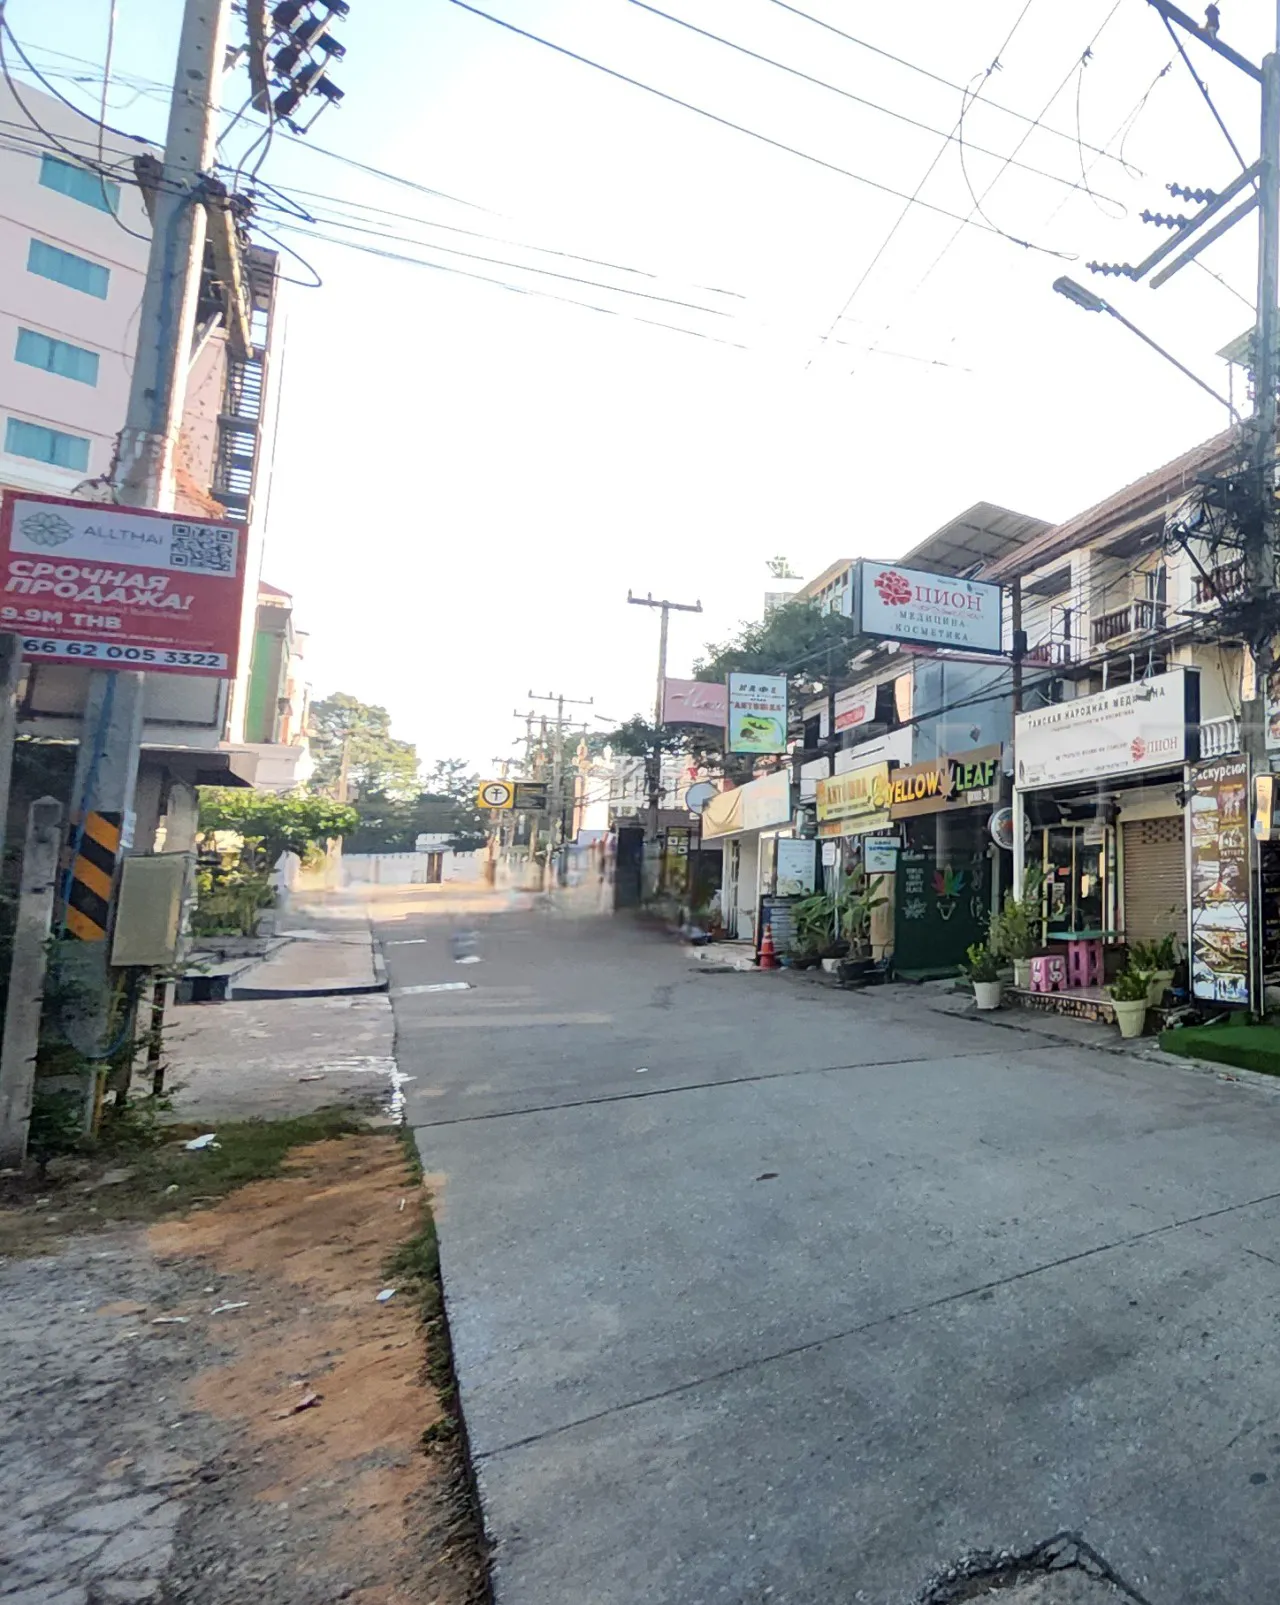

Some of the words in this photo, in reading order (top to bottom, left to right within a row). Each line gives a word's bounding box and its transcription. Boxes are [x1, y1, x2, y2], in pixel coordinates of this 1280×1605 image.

[82, 524, 164, 546] ALLTHAI
[8, 560, 170, 591] СРОЧНАЯ
[4, 577, 195, 610] ПРОДАЖА!
[914, 584, 983, 612] ПИОН
[0, 606, 62, 625] 9.9M
[70, 612, 122, 629] THB
[894, 623, 969, 642] КОСМЕТИКА
[23, 639, 57, 654] 66
[66, 643, 97, 657] 62
[106, 646, 156, 661] 005
[164, 651, 220, 667] 3322
[888, 771, 939, 803] YELLOW
[956, 760, 994, 791] LEAF
